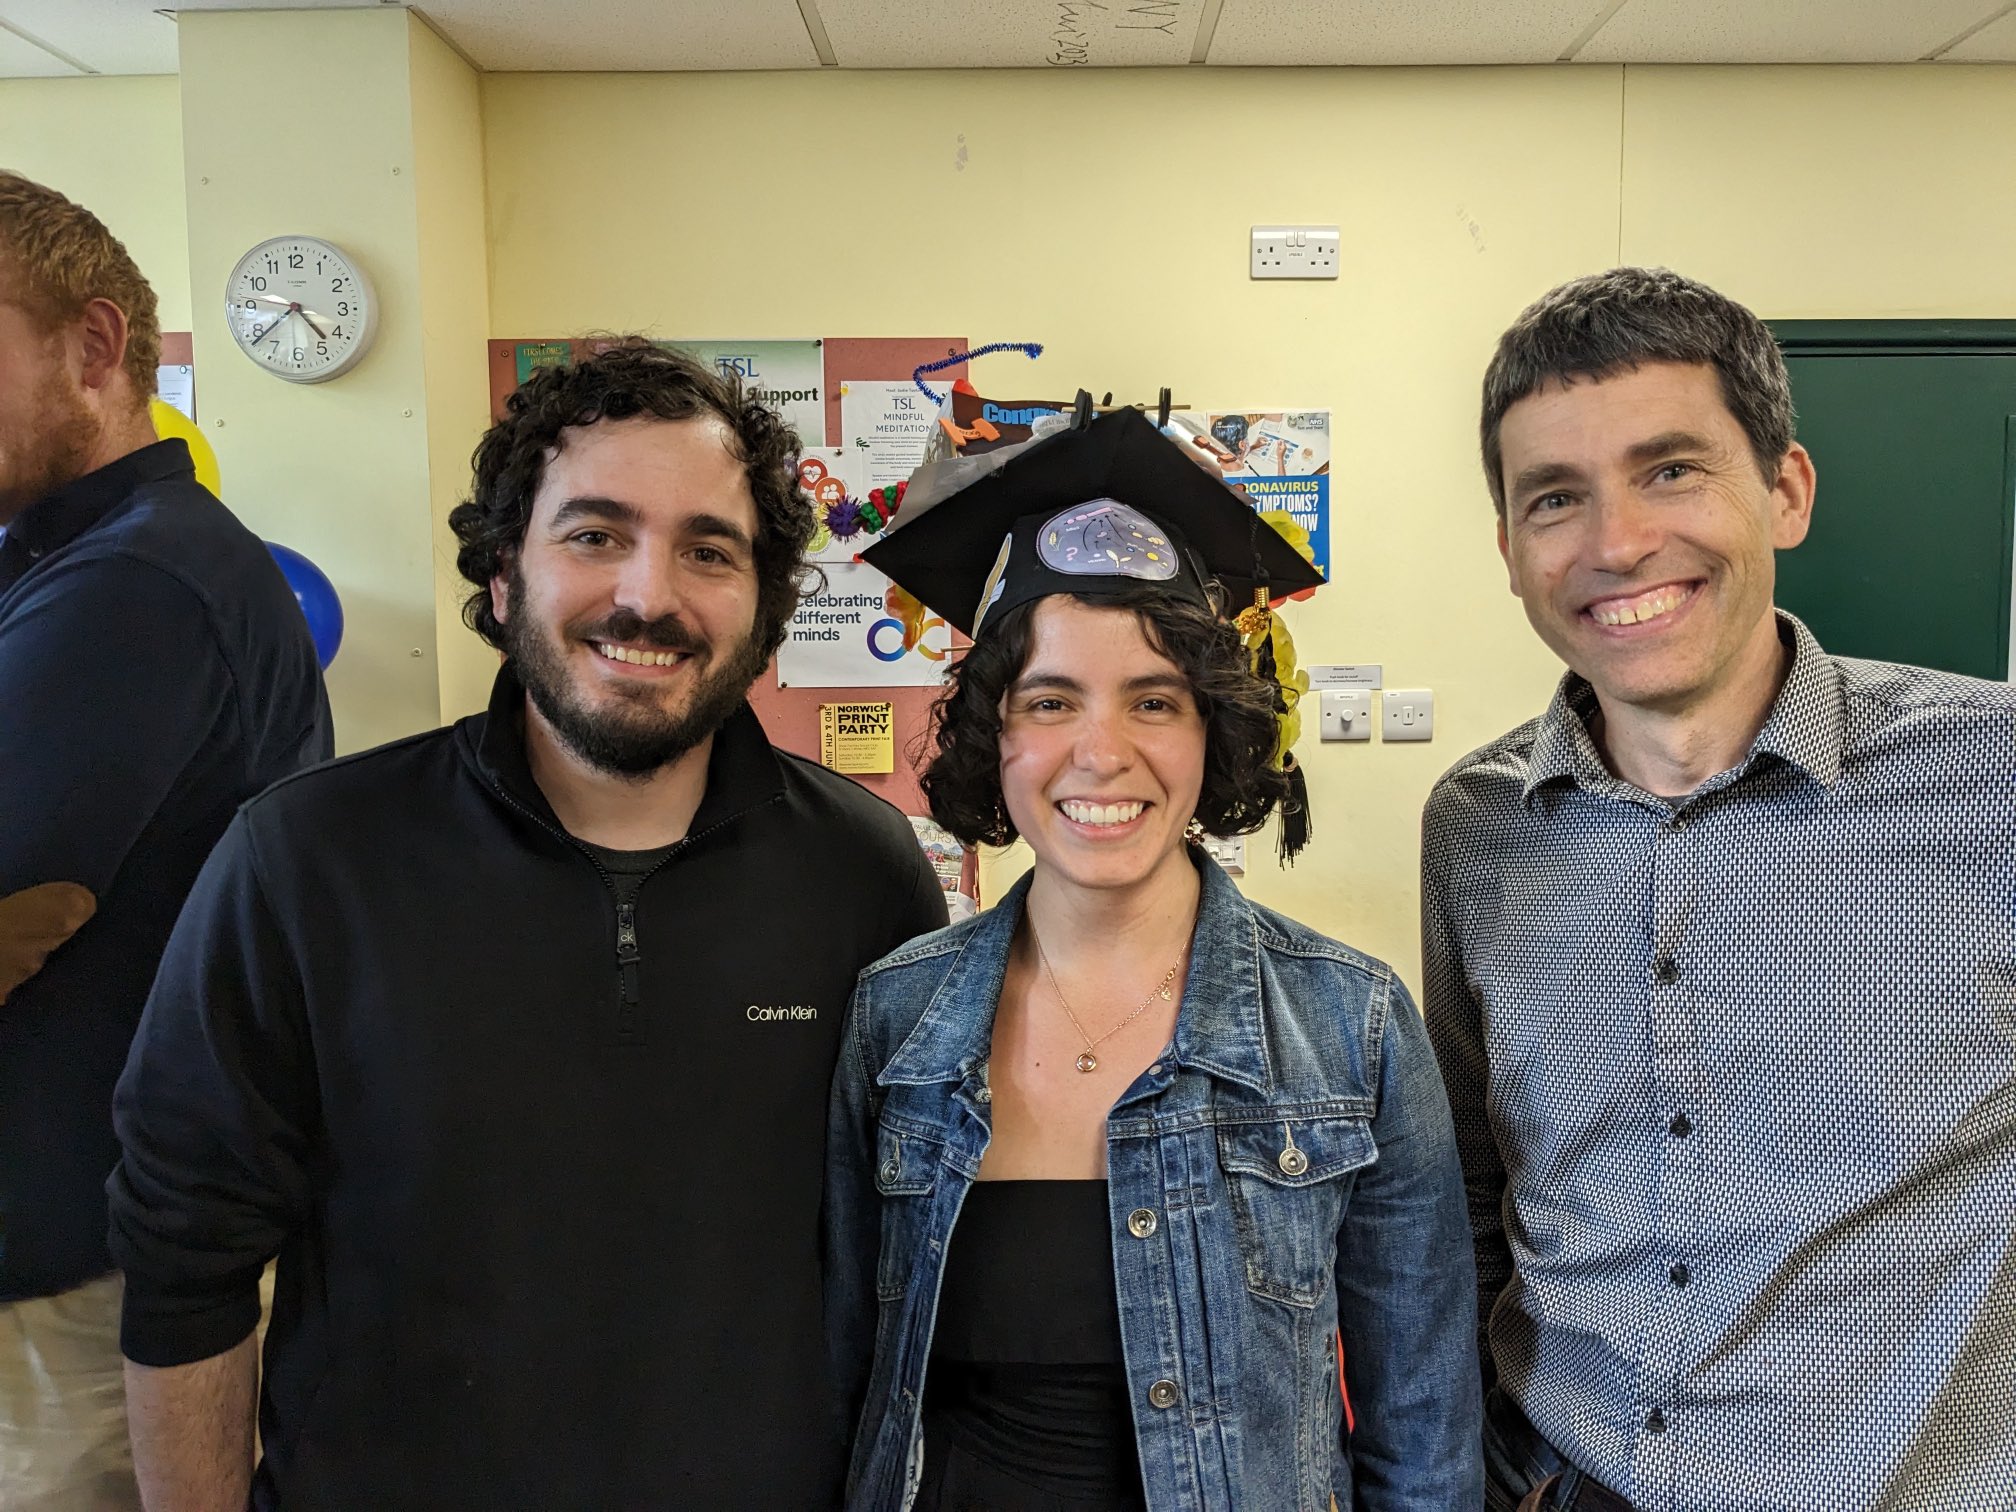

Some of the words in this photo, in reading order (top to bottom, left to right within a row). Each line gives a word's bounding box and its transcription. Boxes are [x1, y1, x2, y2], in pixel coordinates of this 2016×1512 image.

[266, 259, 279, 275] 11
[287, 254, 304, 269] 12
[316, 260, 322, 275] 1
[249, 276, 267, 291] 10
[331, 278, 343, 293] 2
[245, 299, 257, 314] 9
[337, 301, 349, 317] 3
[252, 323, 264, 338] 8
[331, 325, 343, 339] 4
[269, 340, 280, 354] 7
[293, 347, 305, 361] 6
[316, 341, 328, 355] 5
[717, 357, 760, 378] TSL
[746, 386, 819, 406] Support
[892, 398, 917, 410] TSL
[883, 413, 925, 421] MINDFUL
[1309, 418, 1324, 426] NHS
[875, 424, 932, 433] MEDITATION
[1292, 513, 1319, 532] NOW
[793, 610, 862, 625] different
[793, 627, 841, 641] minds
[824, 706, 833, 722] 3RD
[837, 705, 890, 713] NORWICH
[838, 713, 890, 724] PRINT
[838, 724, 890, 735] PARTY
[825, 732, 833, 748] 4TH
[620, 931, 634, 942] ck
[746, 1004, 789, 1021] Calvin
[789, 1004, 818, 1020] Klein
